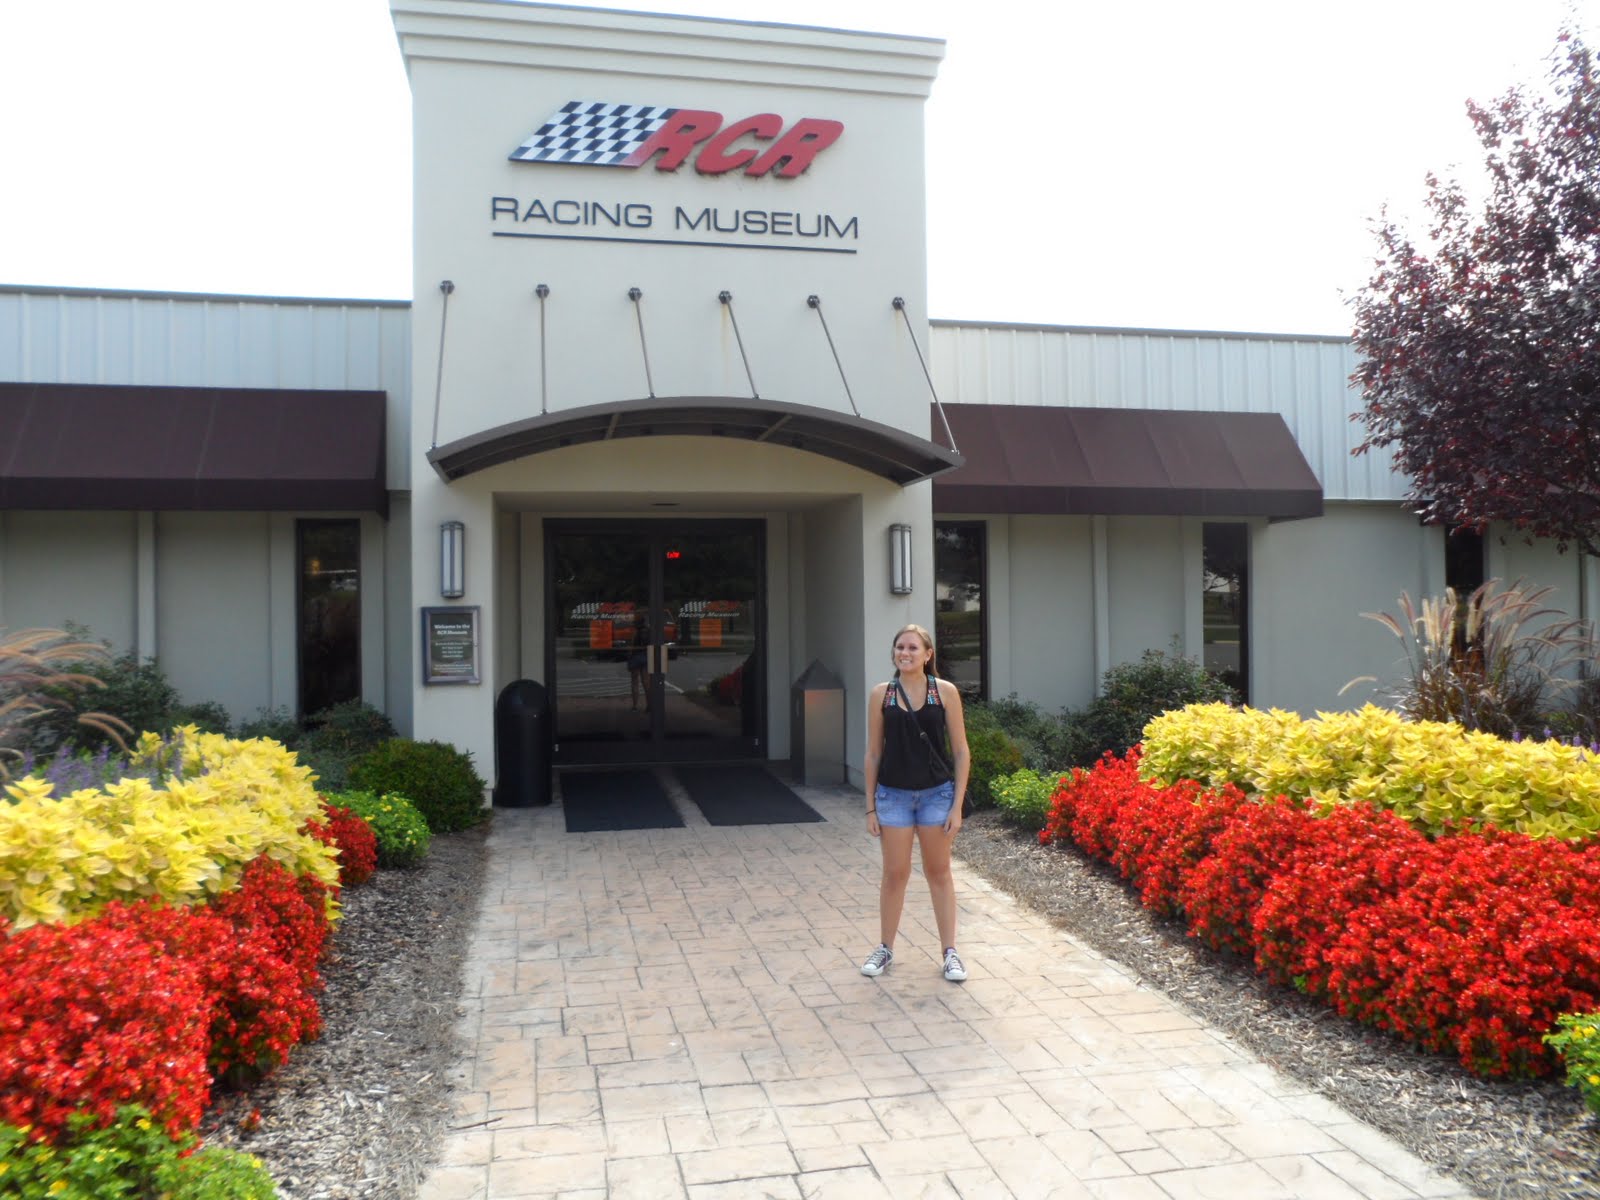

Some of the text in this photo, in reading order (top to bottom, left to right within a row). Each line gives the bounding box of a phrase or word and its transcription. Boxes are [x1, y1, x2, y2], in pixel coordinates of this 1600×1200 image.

[620, 108, 844, 178] RCR
[492, 196, 859, 240] RACING MUSEUM
